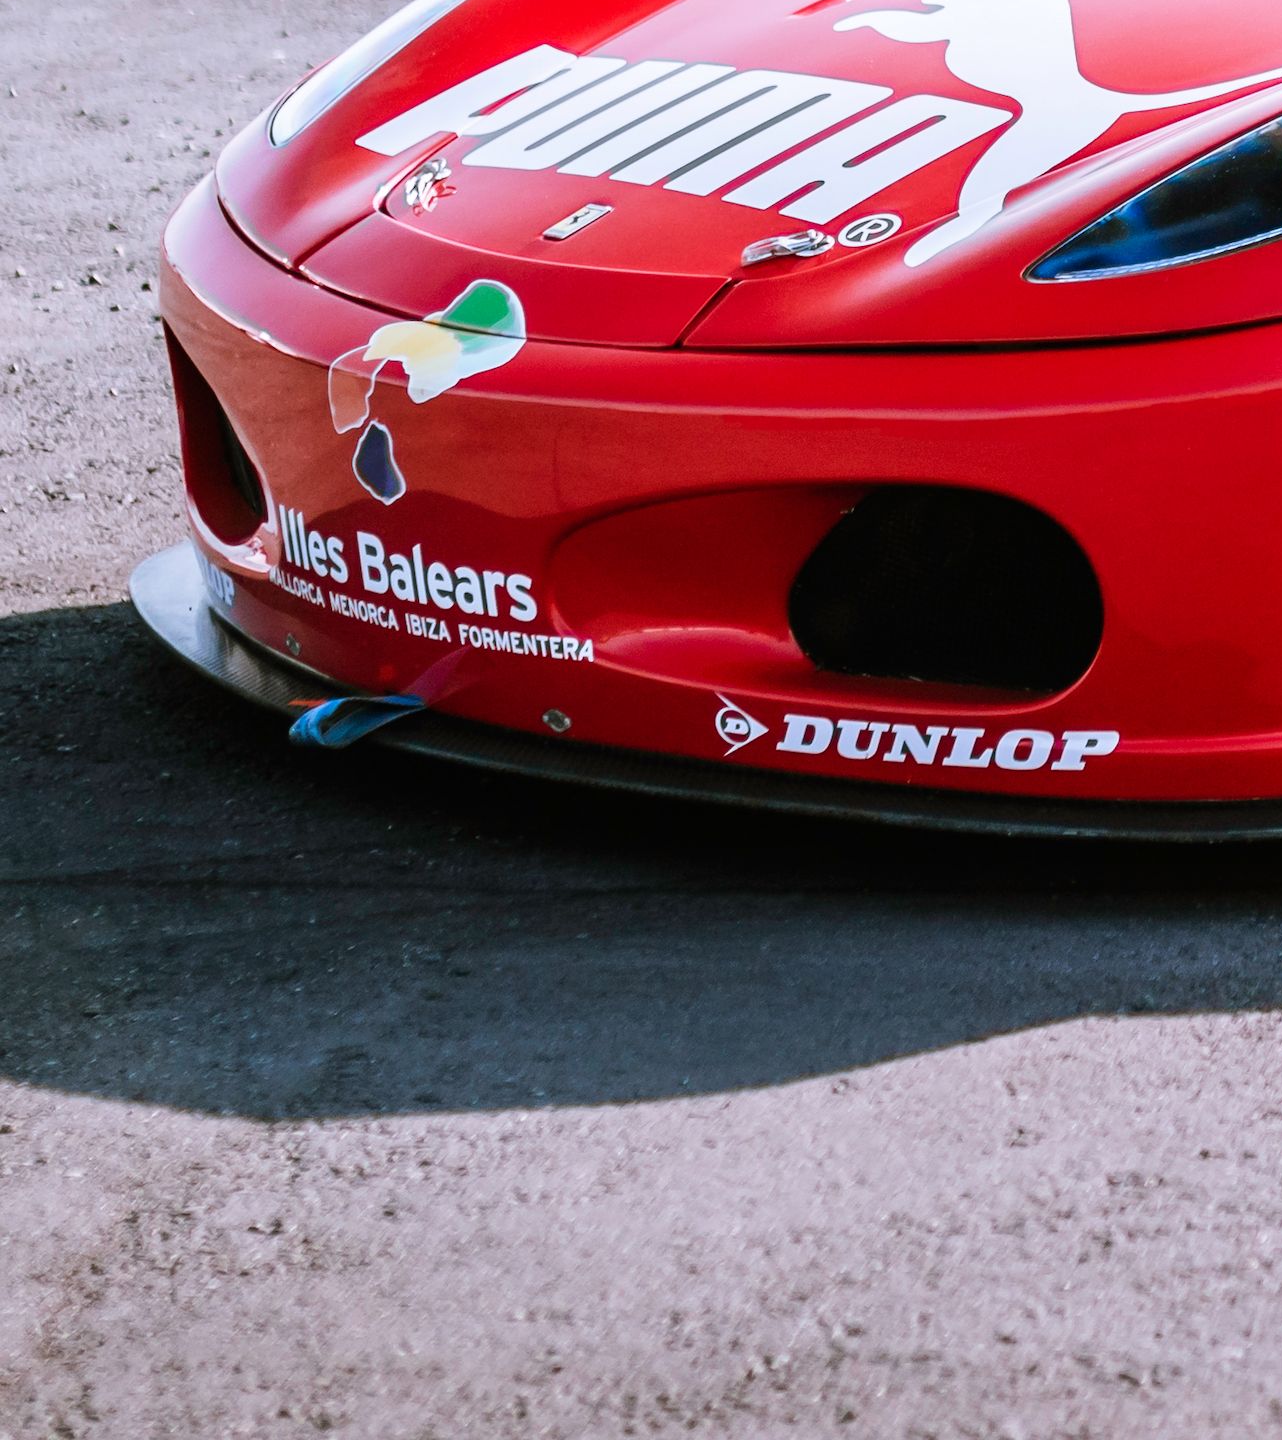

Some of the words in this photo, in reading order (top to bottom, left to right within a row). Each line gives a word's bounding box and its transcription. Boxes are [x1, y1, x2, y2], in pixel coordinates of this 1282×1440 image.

[355, 44, 1013, 225] PUMA
[268, 567, 325, 608] MALLORCA
[330, 591, 399, 631] MENORCA
[406, 613, 451, 643] IBIZA
[459, 623, 594, 662] FORMENTERA
[279, 504, 348, 584] Illes
[357, 531, 538, 623] Balears
[776, 713, 1120, 772] DUNLOP
